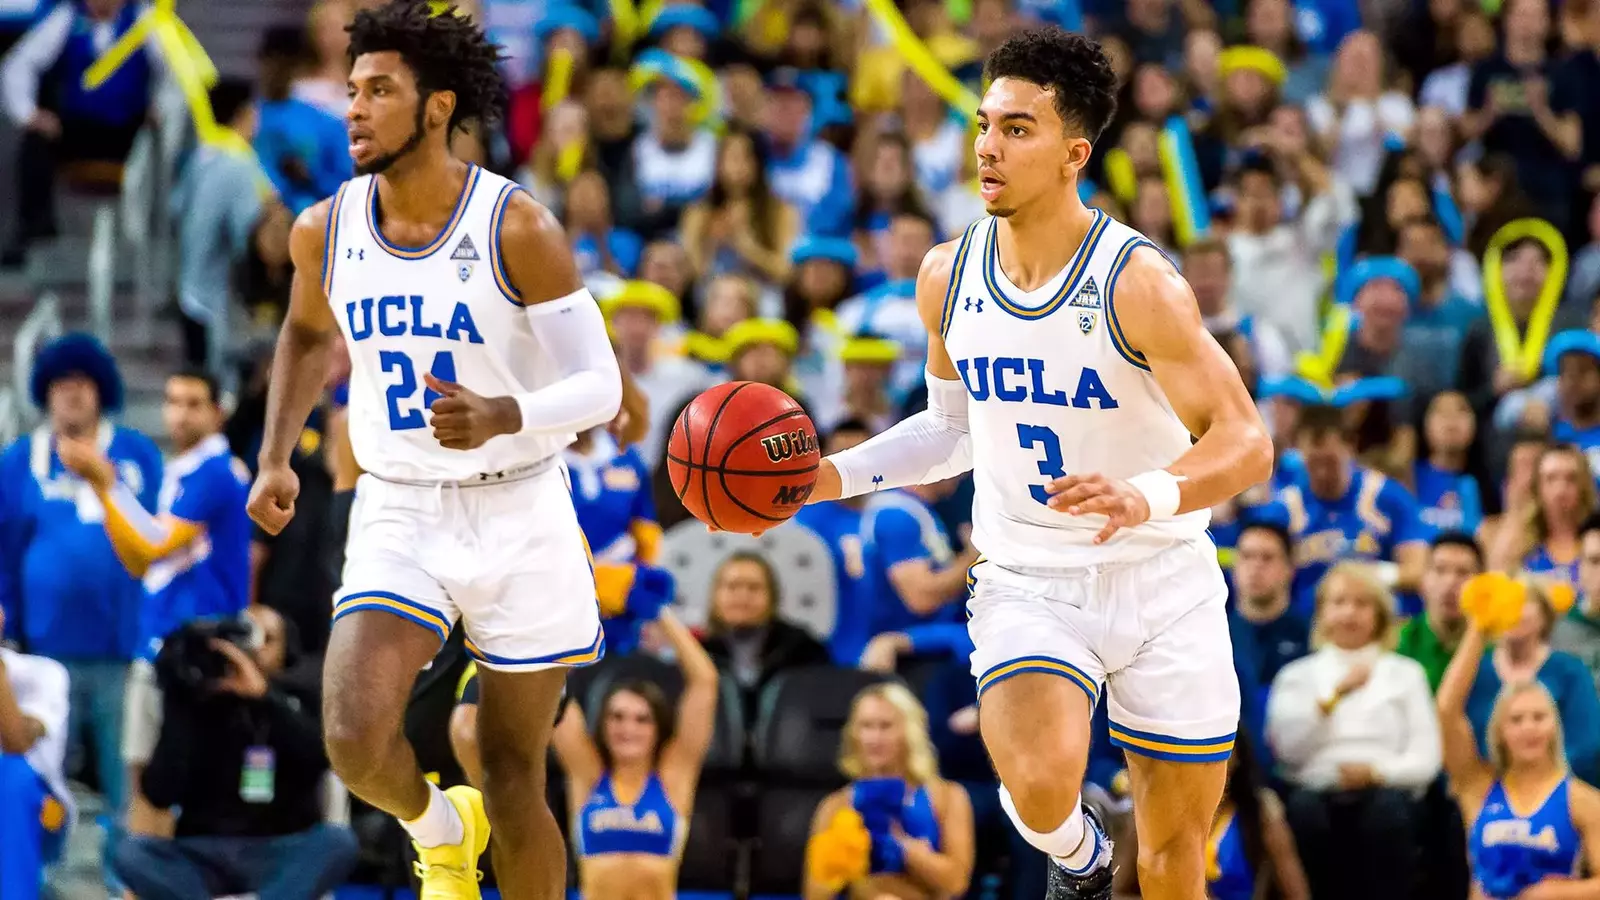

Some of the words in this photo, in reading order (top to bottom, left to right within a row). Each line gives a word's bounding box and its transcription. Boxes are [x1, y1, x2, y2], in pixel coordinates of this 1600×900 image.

[346, 295, 484, 344] UCLA
[378, 351, 457, 431] 24
[957, 357, 1119, 409] UCLA
[761, 428, 819, 463] Wils
[1016, 423, 1066, 505] 3
[772, 483, 815, 504] NC
